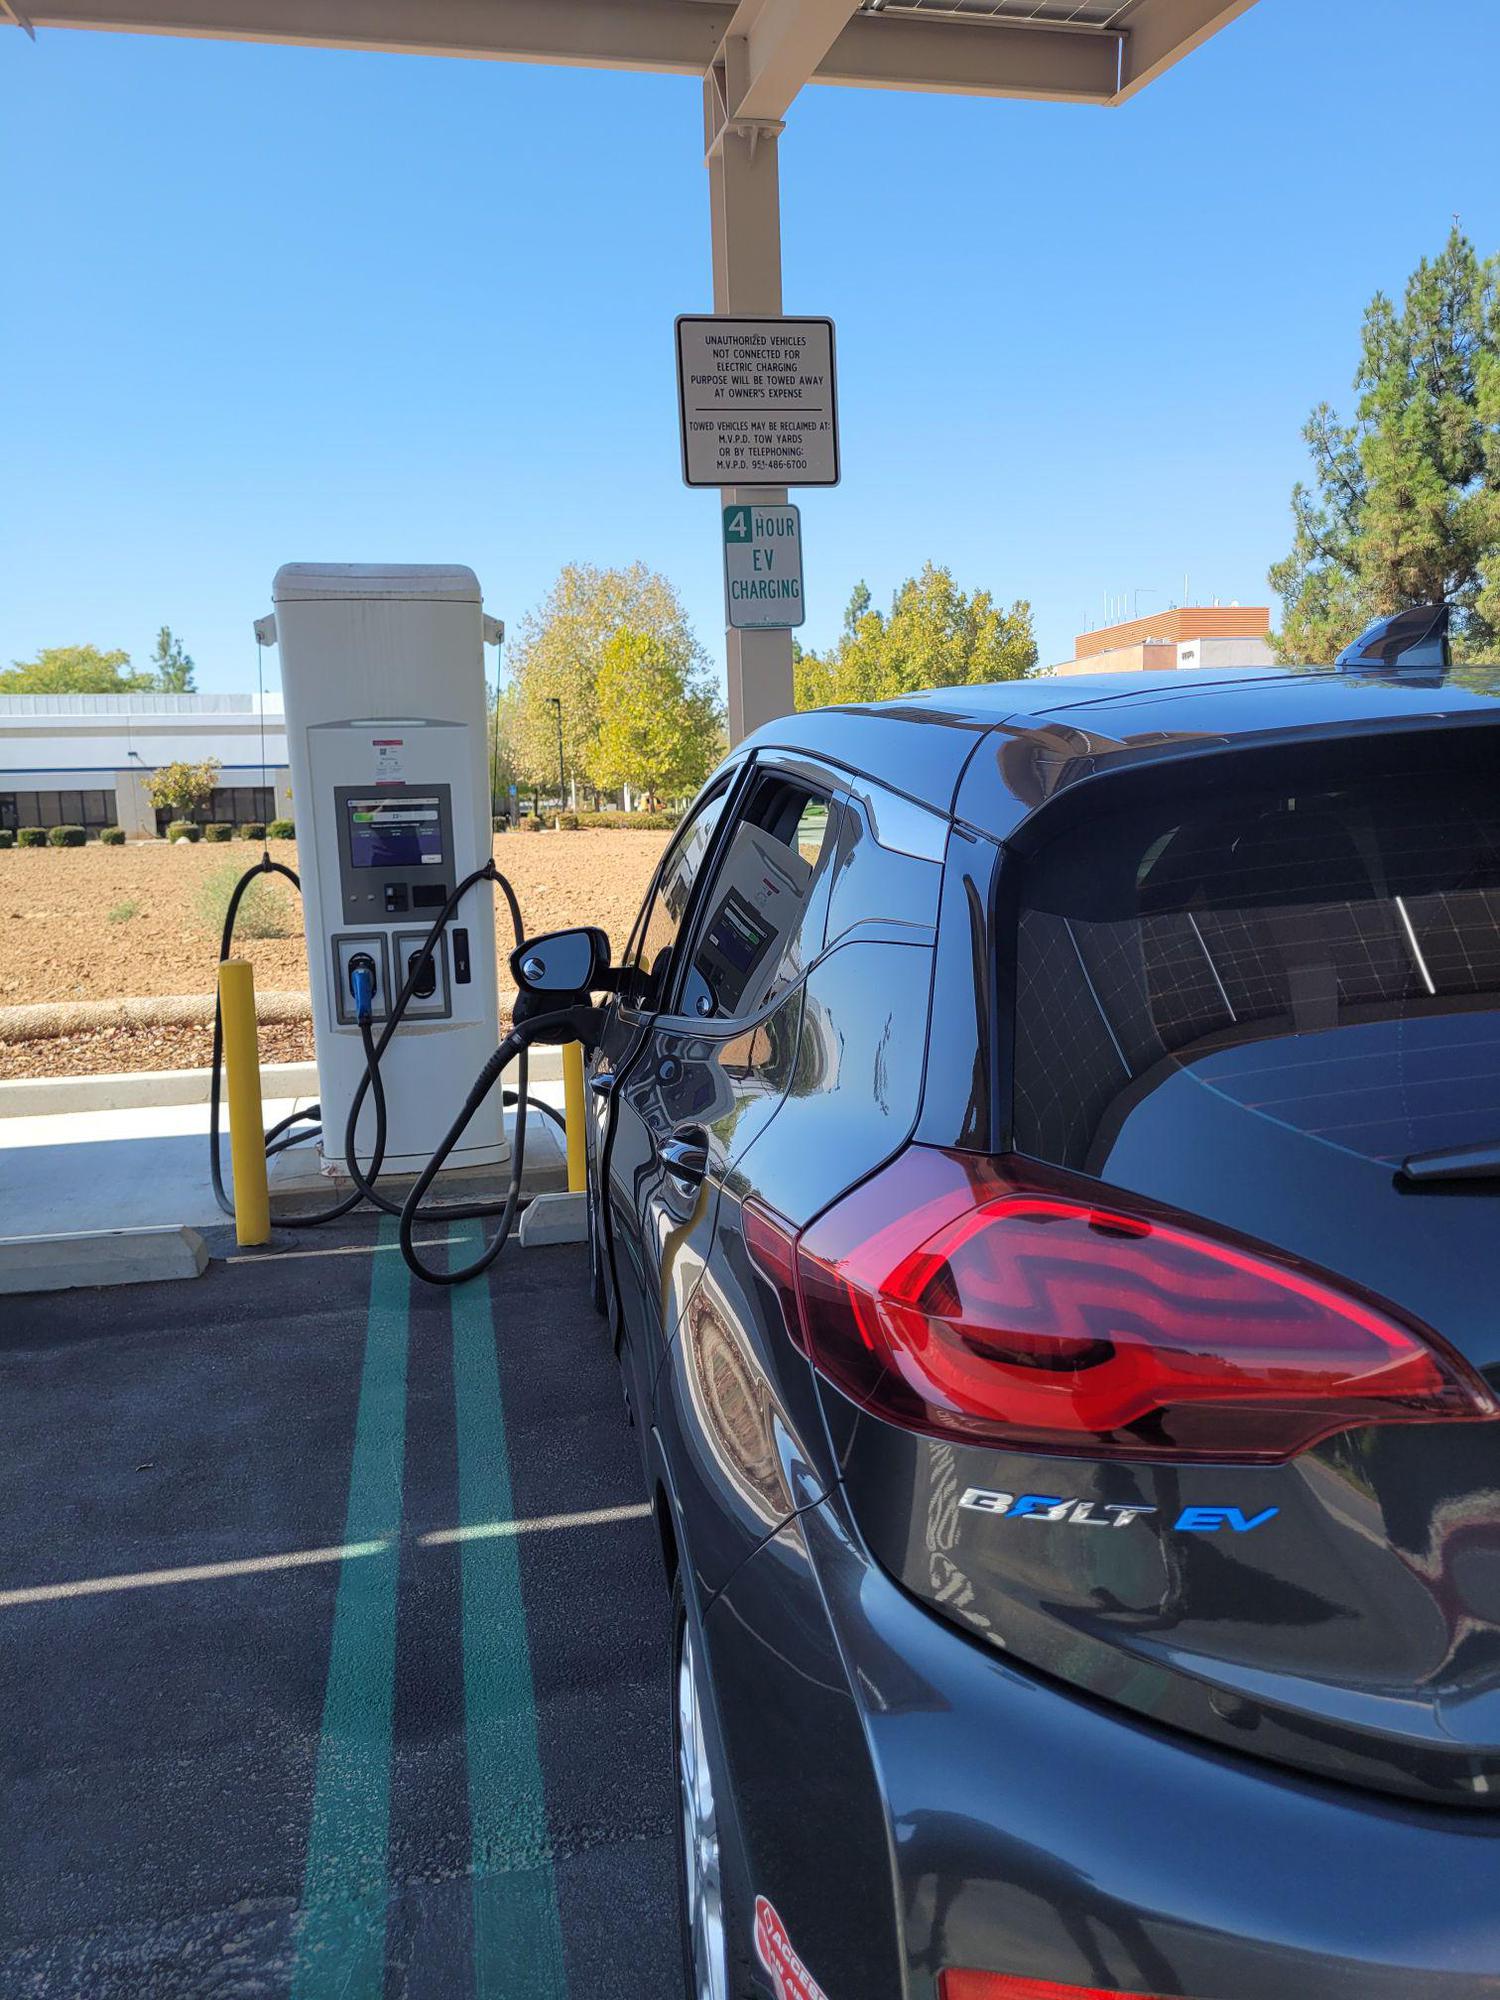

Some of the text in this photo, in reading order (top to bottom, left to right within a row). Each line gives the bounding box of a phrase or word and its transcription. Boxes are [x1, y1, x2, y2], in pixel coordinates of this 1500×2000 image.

[705, 335, 807, 346] UNAUTHORIZED VEHICLES
[713, 349, 800, 359] NOT CONNECTED FOR
[717, 362, 798, 372] ELECTRIC CHARGING
[690, 375, 824, 385] PURPOSE WILL BE TOWED AWAY
[714, 388, 803, 398] AT OWNER'S EXPENSE
[689, 421, 714, 431] TOWED
[717, 421, 749, 431] VEHICLES
[751, 421, 766, 431] MAY
[769, 421, 777, 431] BE
[780, 421, 817, 431] RECLAIMED
[718, 434, 803, 444] M.V.P.D. TOW YARDS
[719, 447, 804, 457] OR BY TELEPHONING:
[716, 460, 807, 470] M.V.P.D. 951-486-6700
[728, 511, 795, 537] 4 HOUR
[753, 548, 774, 571] EV
[731, 579, 800, 600] CHARGING
[958, 1487, 1281, 1532] BOLT EV
